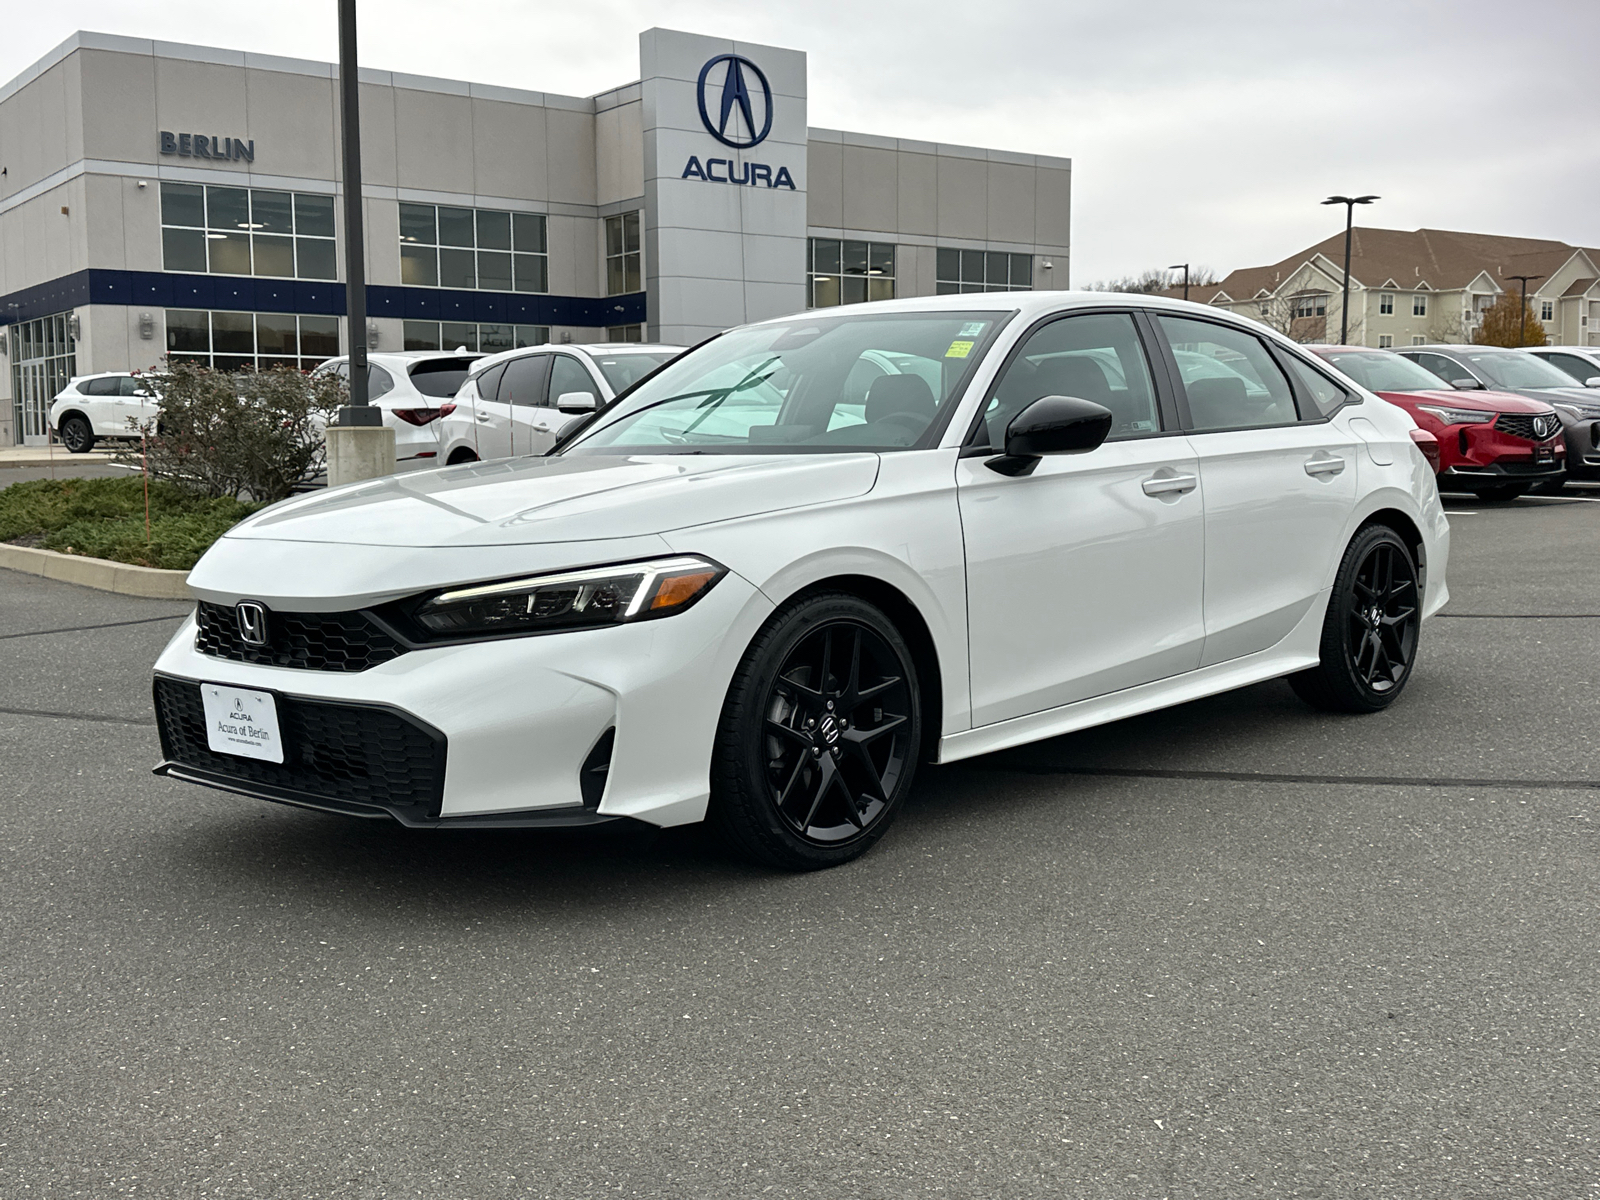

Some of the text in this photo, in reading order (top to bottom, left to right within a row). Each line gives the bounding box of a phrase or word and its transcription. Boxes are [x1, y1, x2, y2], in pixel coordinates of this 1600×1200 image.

[160, 131, 254, 162] BERLIN
[682, 155, 796, 190] ACURA
[483, 339, 527, 348] ACUA
[229, 712, 253, 722] ACURA
[218, 721, 270, 740] Acura of Berlin
